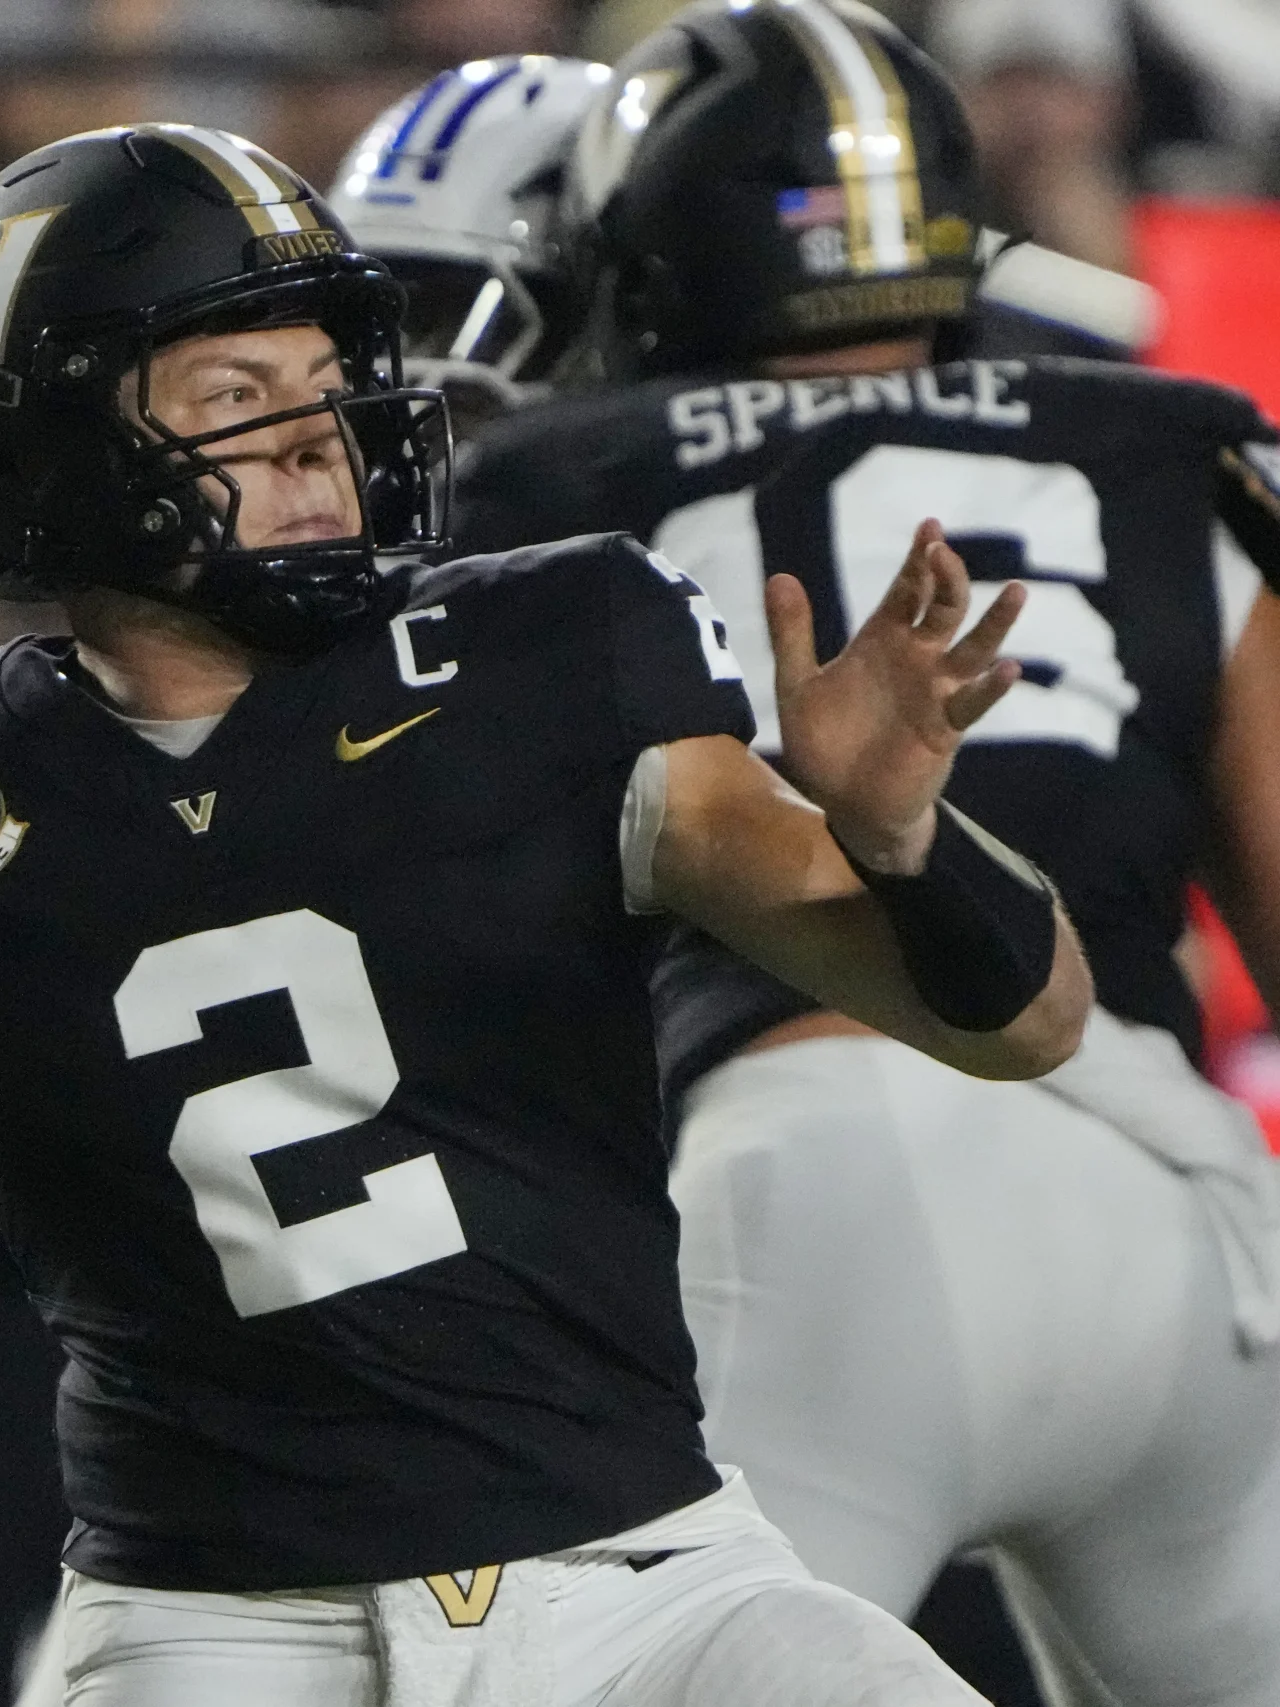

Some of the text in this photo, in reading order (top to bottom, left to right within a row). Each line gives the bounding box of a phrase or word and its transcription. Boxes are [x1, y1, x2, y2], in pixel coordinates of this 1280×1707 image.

[668, 358, 1031, 470] SPENCE
[390, 604, 459, 687] C
[170, 791, 217, 835] V
[113, 908, 468, 1319] 2
